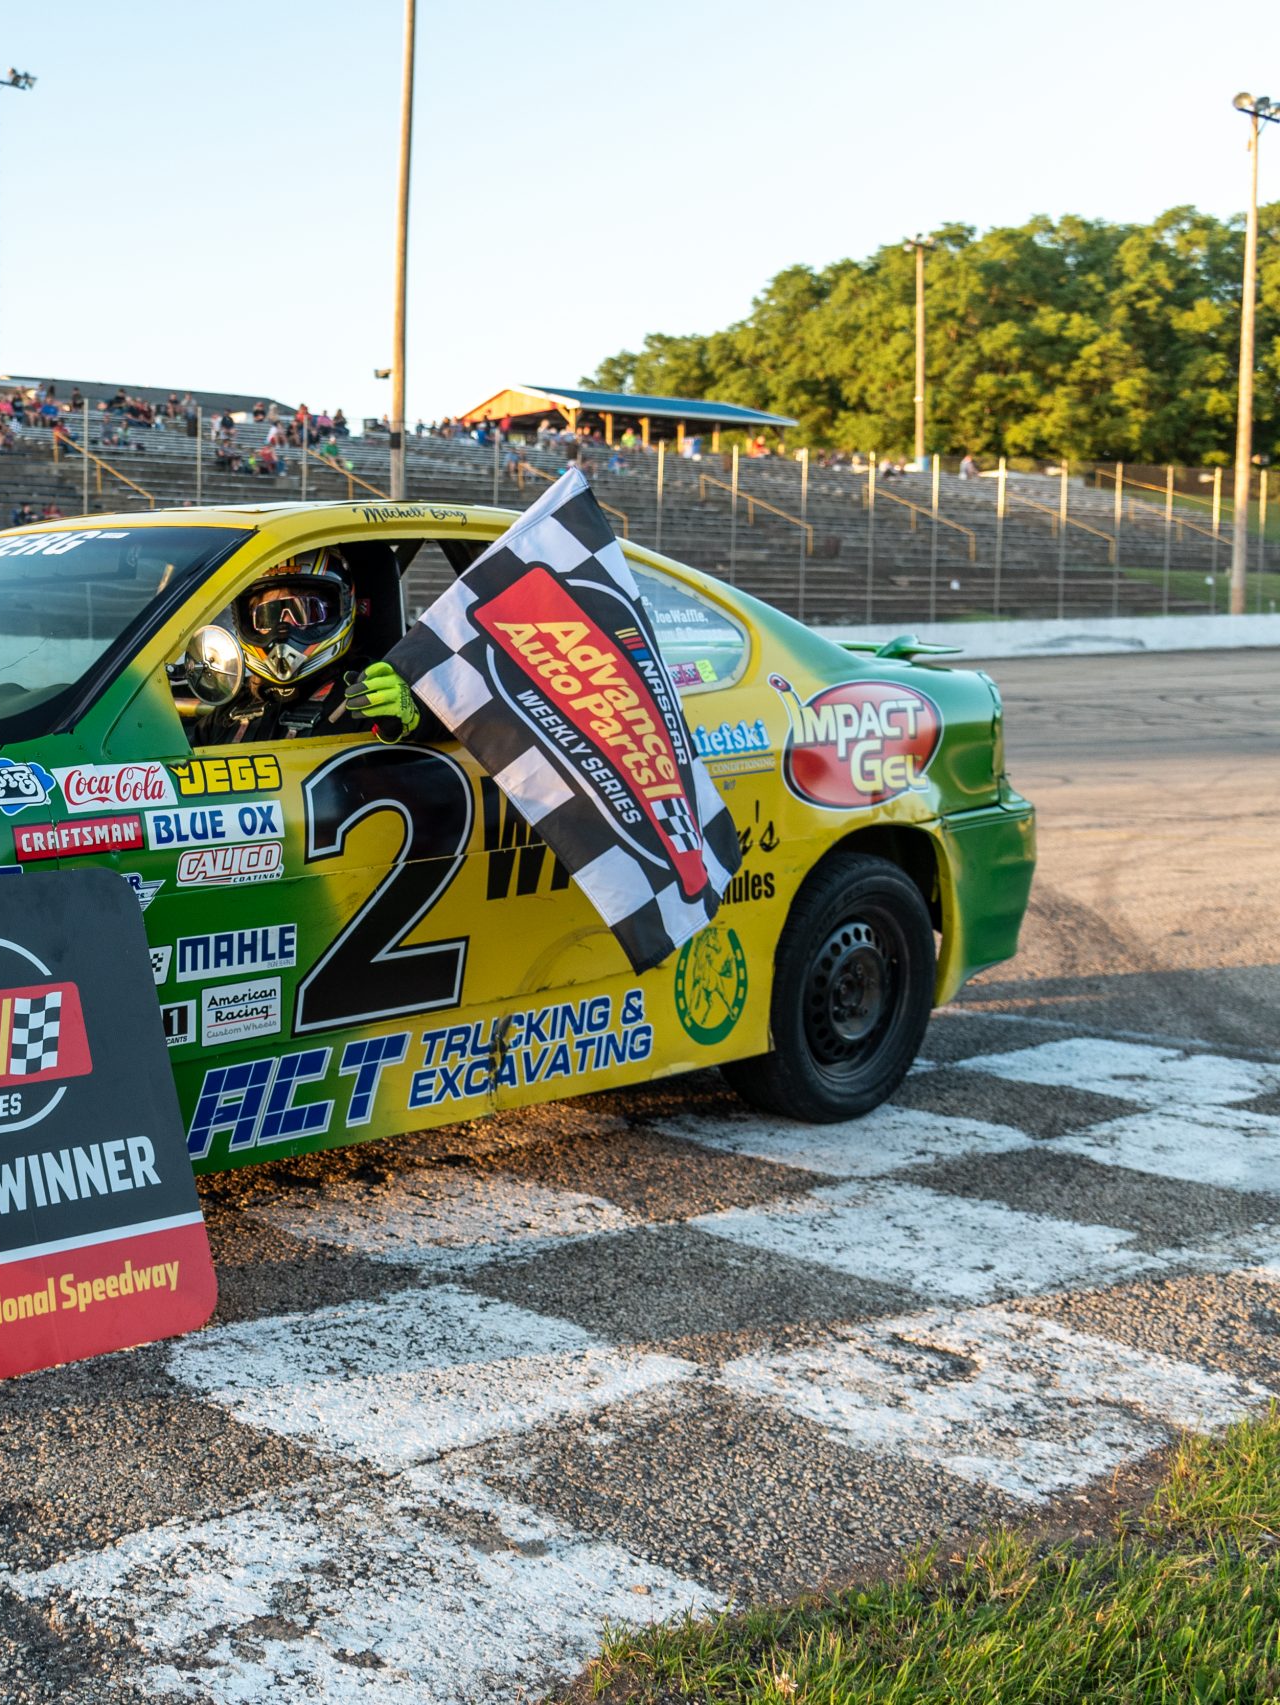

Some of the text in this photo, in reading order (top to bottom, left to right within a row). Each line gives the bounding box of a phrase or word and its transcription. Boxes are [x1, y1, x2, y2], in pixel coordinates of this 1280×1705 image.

[493, 621, 657, 785] Auto Parts
[534, 621, 676, 780] Advance
[637, 659, 688, 765] NASCAR
[170, 755, 281, 796] JEGS
[516, 689, 642, 824] WEEKLY SERIES
[64, 765, 166, 806] Coca-Cola
[21, 821, 137, 853] CRAFTSMAN
[153, 805, 278, 845] BLUE OX
[178, 842, 282, 882] CALICO
[232, 872, 281, 884] COATINGS
[292, 742, 475, 1037] 2
[178, 925, 296, 973] MAHLE
[207, 988, 277, 1009] American
[214, 1004, 270, 1023] Racing
[206, 1020, 277, 1039] Custom Wheels
[421, 988, 645, 1067] TRUCKING &
[407, 1024, 653, 1109] EXCAVATING
[187, 1032, 412, 1160] ACT
[59, 1260, 180, 1312] Speedway
